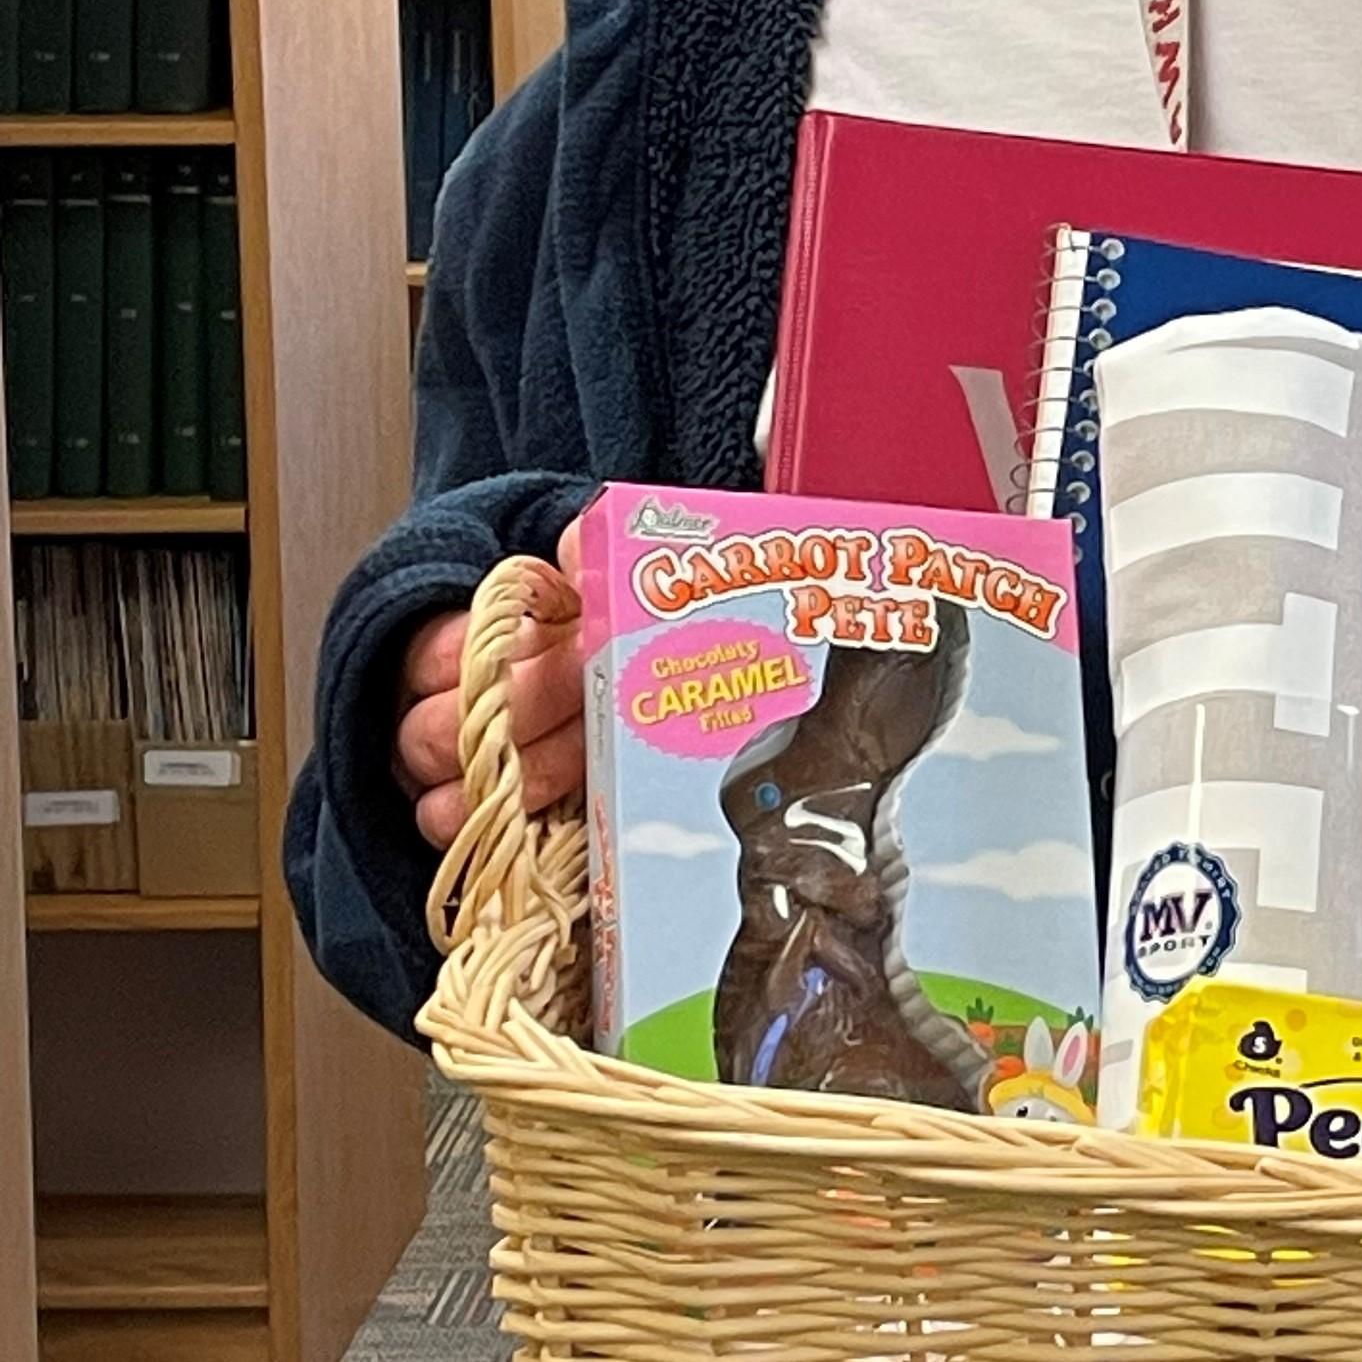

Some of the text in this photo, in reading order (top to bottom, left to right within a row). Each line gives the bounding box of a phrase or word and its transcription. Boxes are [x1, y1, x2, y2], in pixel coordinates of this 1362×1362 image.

[638, 533, 1062, 634] CARROT PATCH
[790, 585, 933, 647] PETE
[630, 654, 808, 725] CARAMEL
[1138, 890, 1214, 943] MV
[1138, 934, 1210, 959] SPORT
